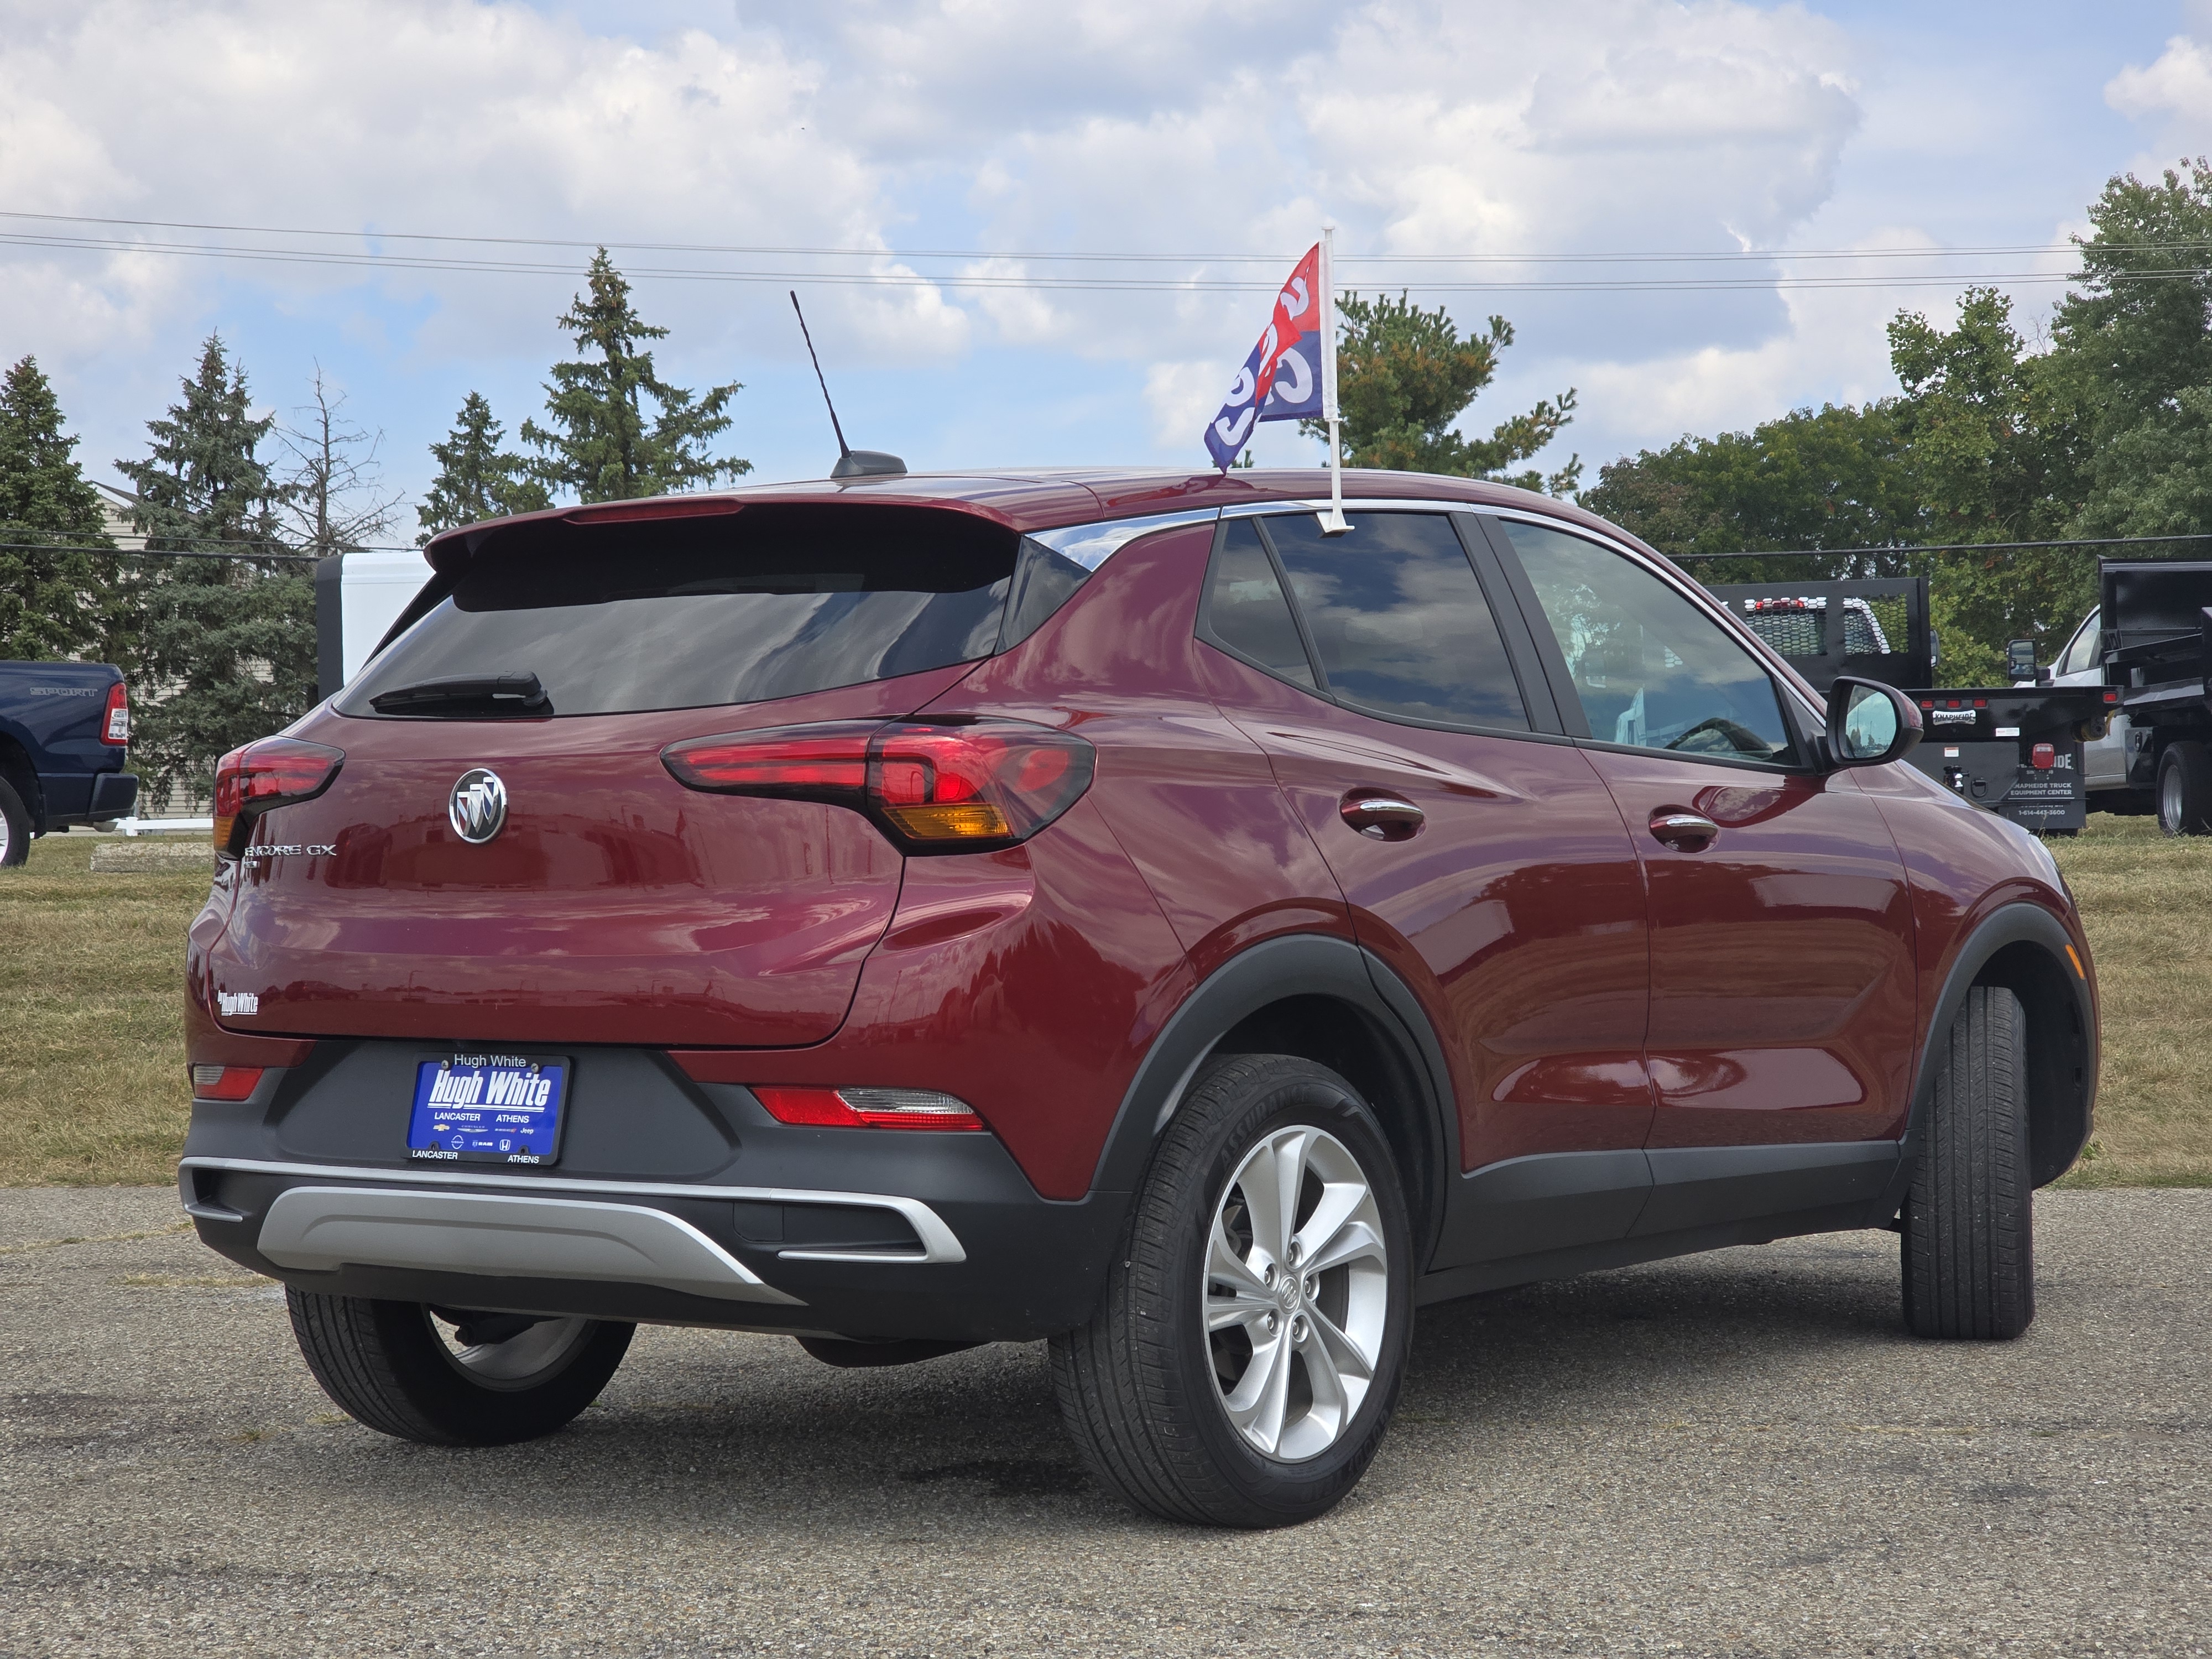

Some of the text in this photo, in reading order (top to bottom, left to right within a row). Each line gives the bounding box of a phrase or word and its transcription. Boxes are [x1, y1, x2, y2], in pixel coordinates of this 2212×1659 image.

[30, 687, 98, 697] SPORT
[1935, 712, 1974, 722] KNAPHEIDE
[244, 844, 337, 857] ENCORE GX
[222, 993, 238, 1015] Hugh
[237, 993, 258, 1012] White
[454, 1054, 526, 1067] Hugh White
[429, 1069, 551, 1109] Hugh White
[434, 1112, 529, 1123] LANCASTER ATHENS
[412, 1150, 540, 1164] LANCASTER ATHENS
